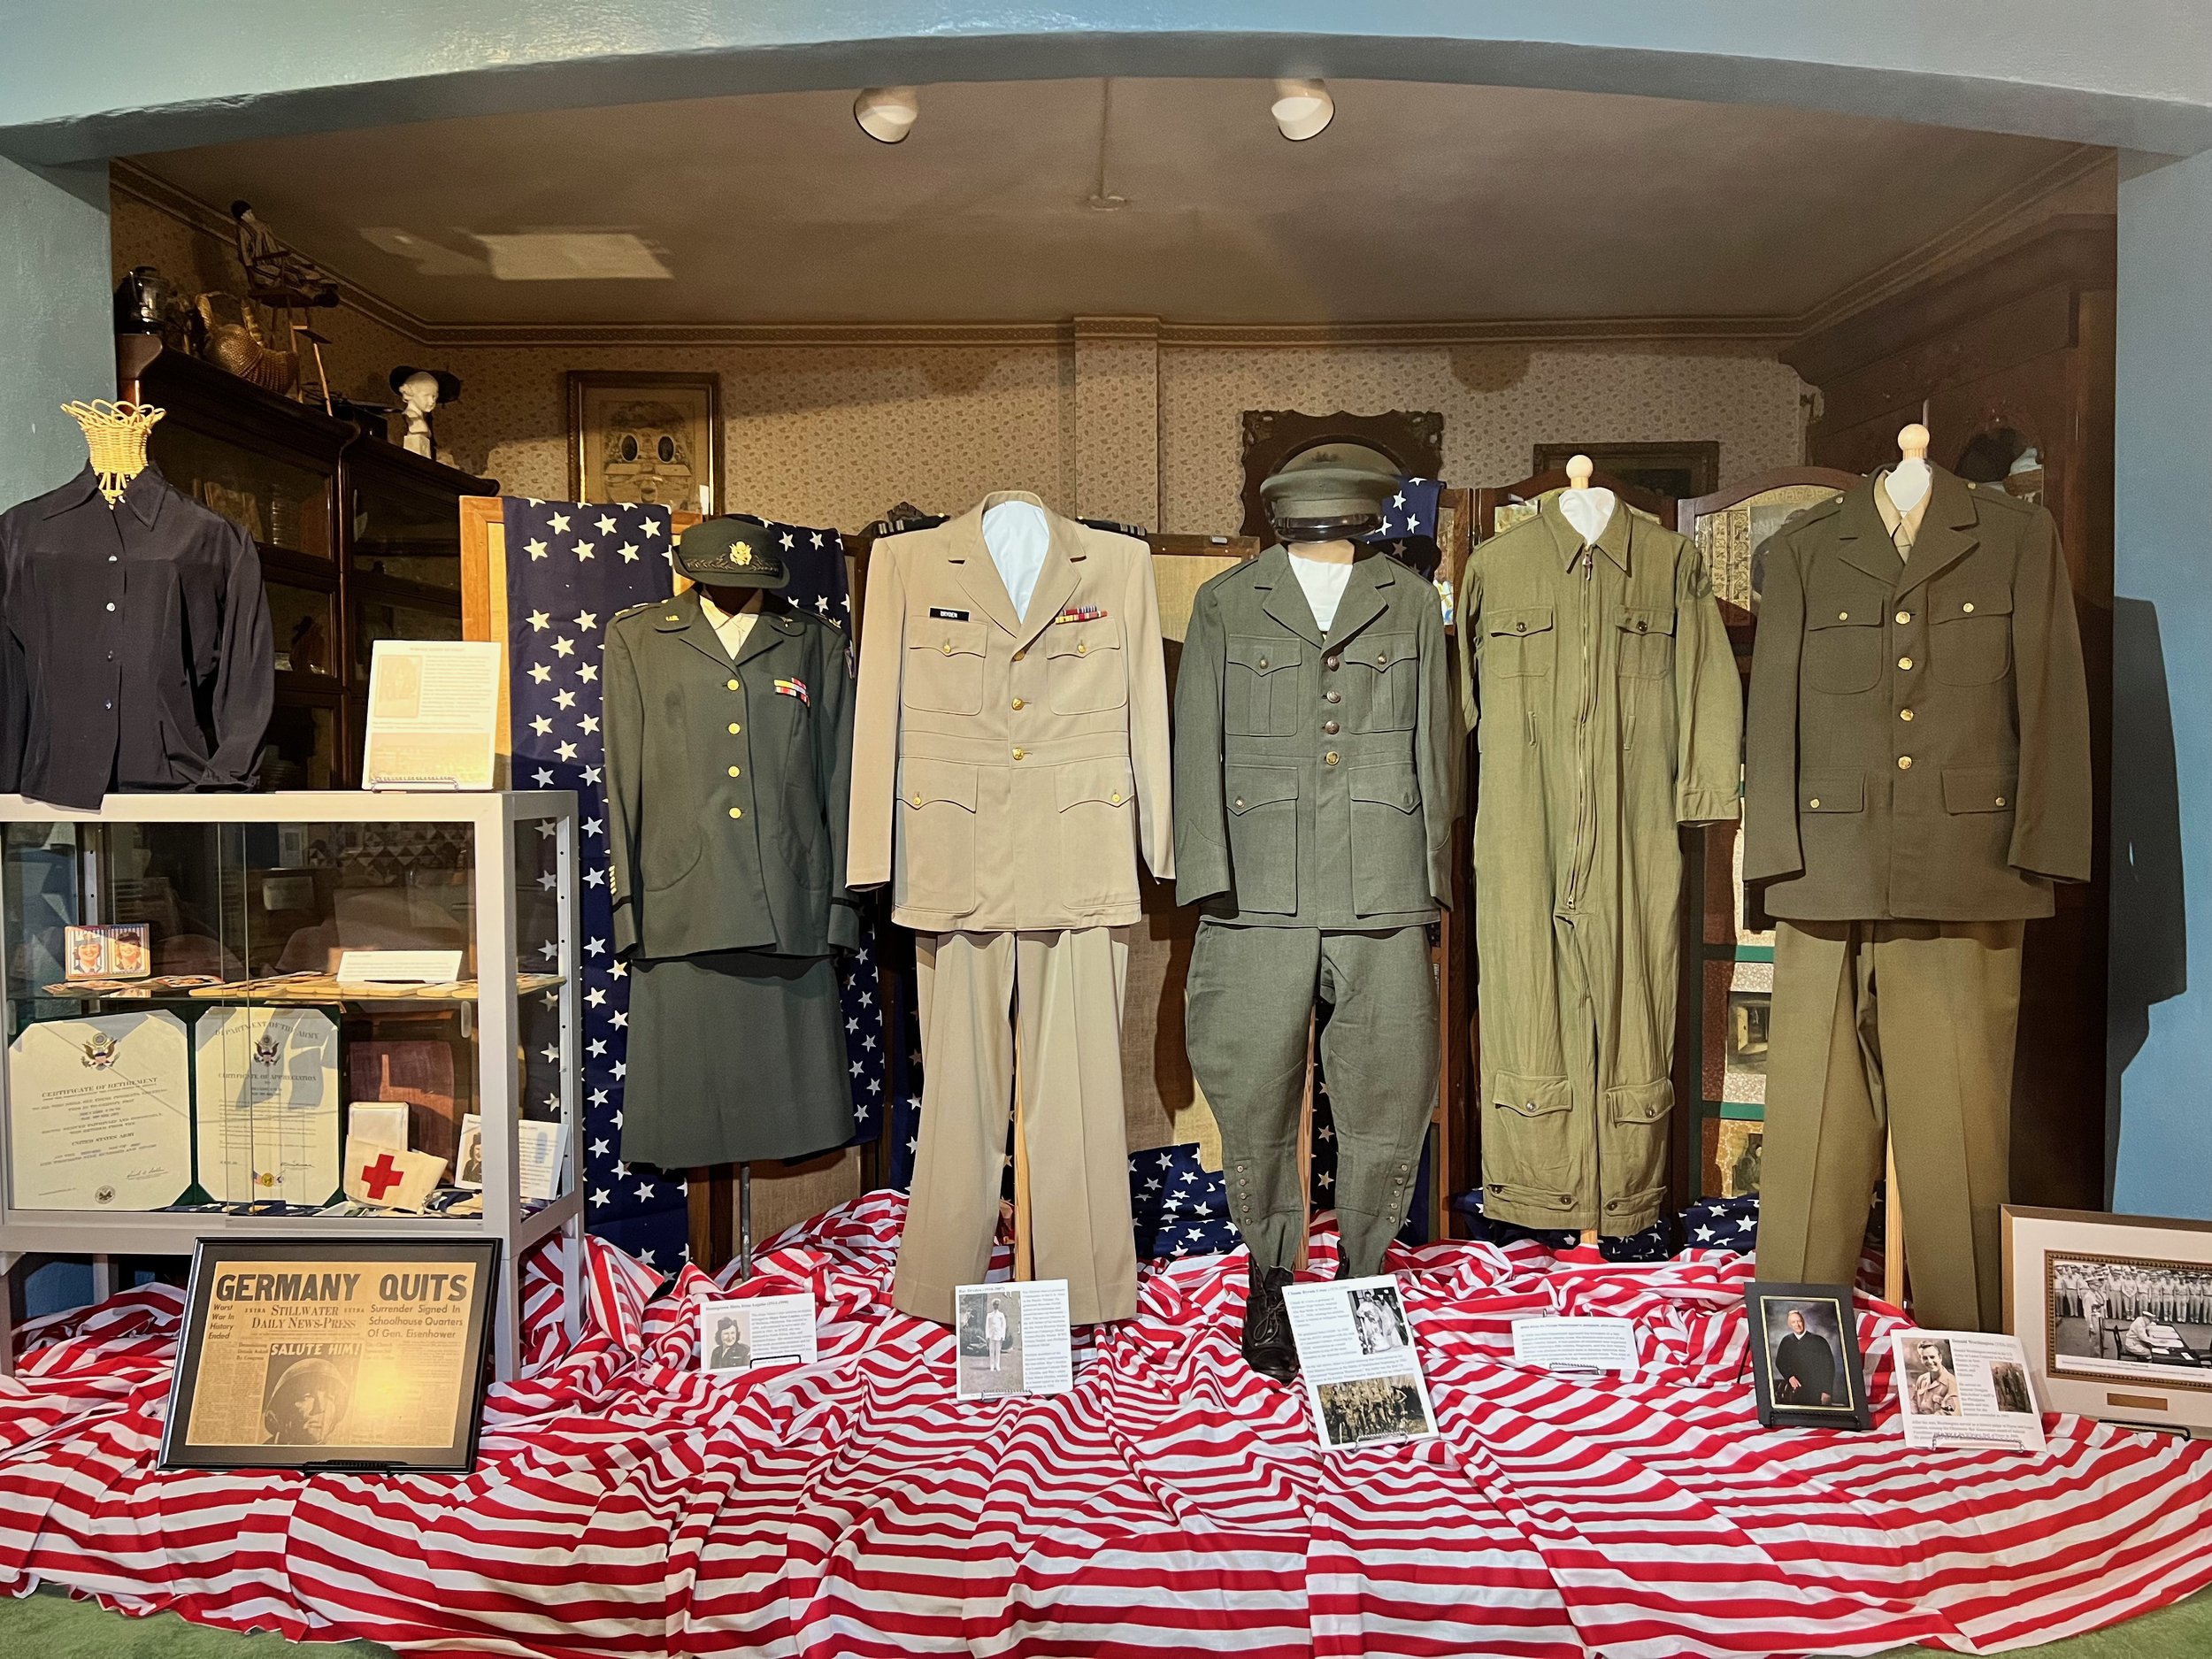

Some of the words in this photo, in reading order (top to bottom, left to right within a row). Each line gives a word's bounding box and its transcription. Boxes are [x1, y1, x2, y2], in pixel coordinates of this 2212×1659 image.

[42, 1086, 95, 1098] CERTIFICATE
[216, 1273, 361, 1302] GERMANY
[379, 1273, 467, 1302] QUITS
[370, 1303, 413, 1313] Surrender
[418, 1304, 448, 1315] Signed
[452, 1304, 461, 1313] In
[210, 1322, 234, 1331] History
[251, 1317, 286, 1329] DAILY
[369, 1316, 423, 1325] Schoolhouse
[425, 1317, 464, 1326] Quarters
[367, 1328, 380, 1337] Of
[381, 1329, 403, 1338] Gen.
[406, 1329, 456, 1339] Eisenhower
[271, 1343, 322, 1356] SALUTE
[328, 1343, 359, 1355] HIM!
